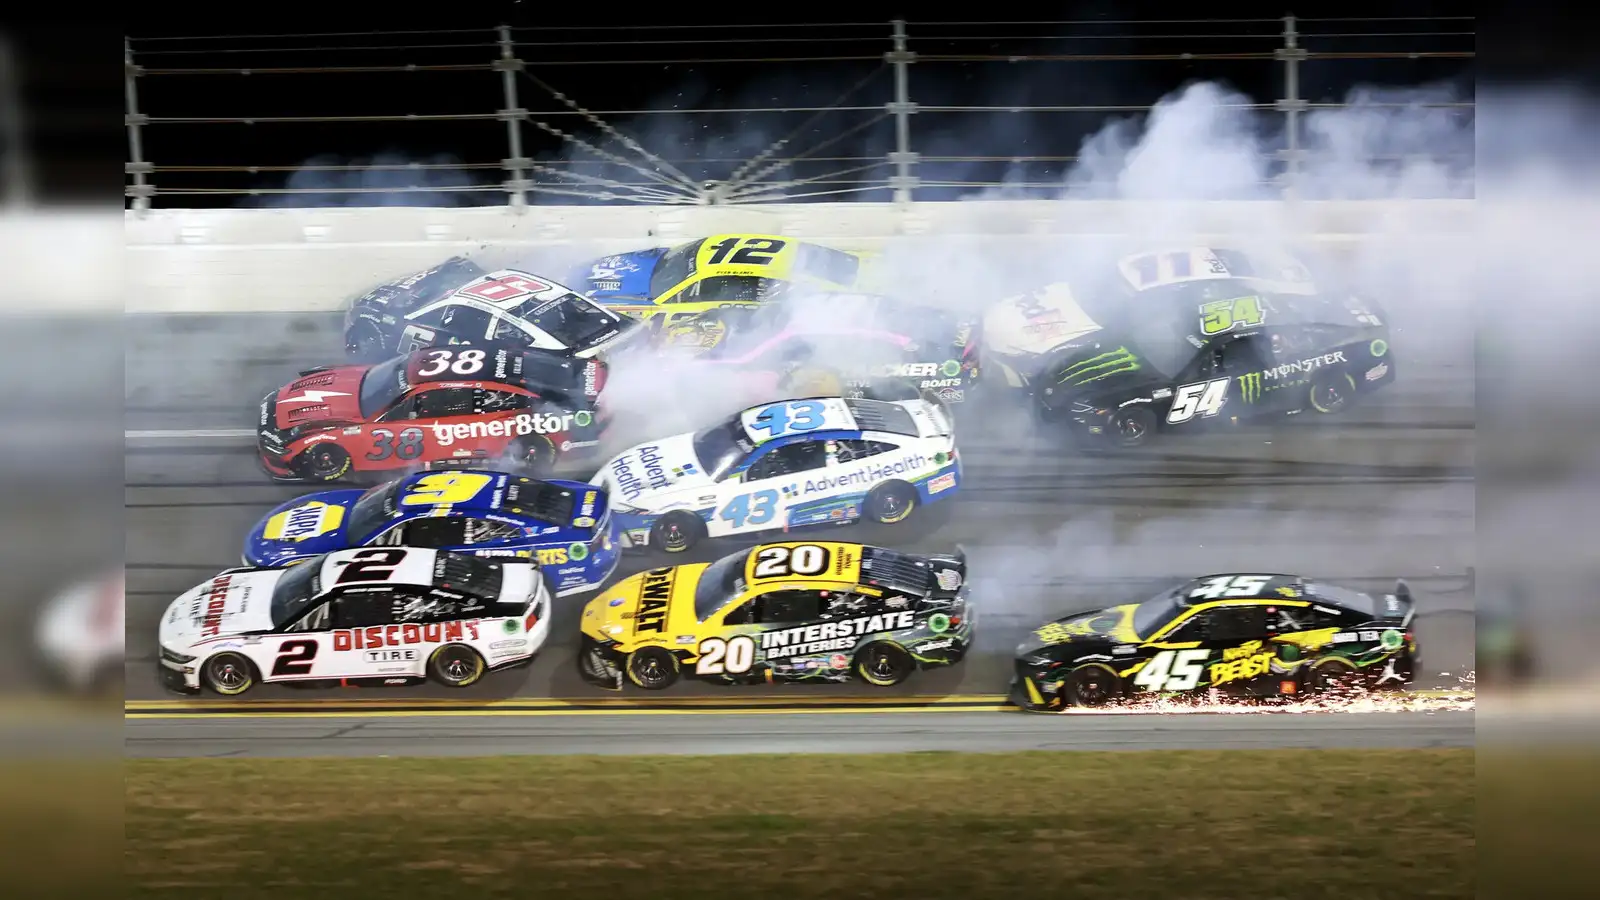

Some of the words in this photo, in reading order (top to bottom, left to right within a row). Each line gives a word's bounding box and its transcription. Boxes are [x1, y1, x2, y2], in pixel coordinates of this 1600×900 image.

[708, 238, 786, 265] 12
[1129, 251, 1192, 286] 11
[1199, 295, 1266, 335] 54
[418, 349, 487, 377] 38
[584, 361, 598, 397] gener8tor
[1264, 351, 1347, 380] MONSTER
[920, 378, 962, 389] BOATS
[1166, 376, 1232, 424] 54
[434, 412, 574, 446] gener8tor
[750, 401, 826, 437] 43
[365, 428, 425, 461] 38
[611, 455, 646, 501] Health
[637, 446, 674, 490] Advent
[401, 473, 493, 506] 9
[285, 507, 323, 537] NAPA
[719, 489, 779, 529] 43
[336, 549, 407, 584] 2
[755, 544, 826, 578] 20
[638, 567, 674, 633] DEWALT
[1189, 575, 1273, 599] 45
[201, 575, 233, 637] DISCOUNT
[333, 617, 481, 651] DISCOUNT
[762, 610, 915, 648] INTERSTATE
[271, 639, 319, 676] 2
[370, 650, 415, 662] TIRE
[696, 636, 755, 675] 20
[767, 636, 858, 659] BATTERIES
[1134, 649, 1212, 692] 45
